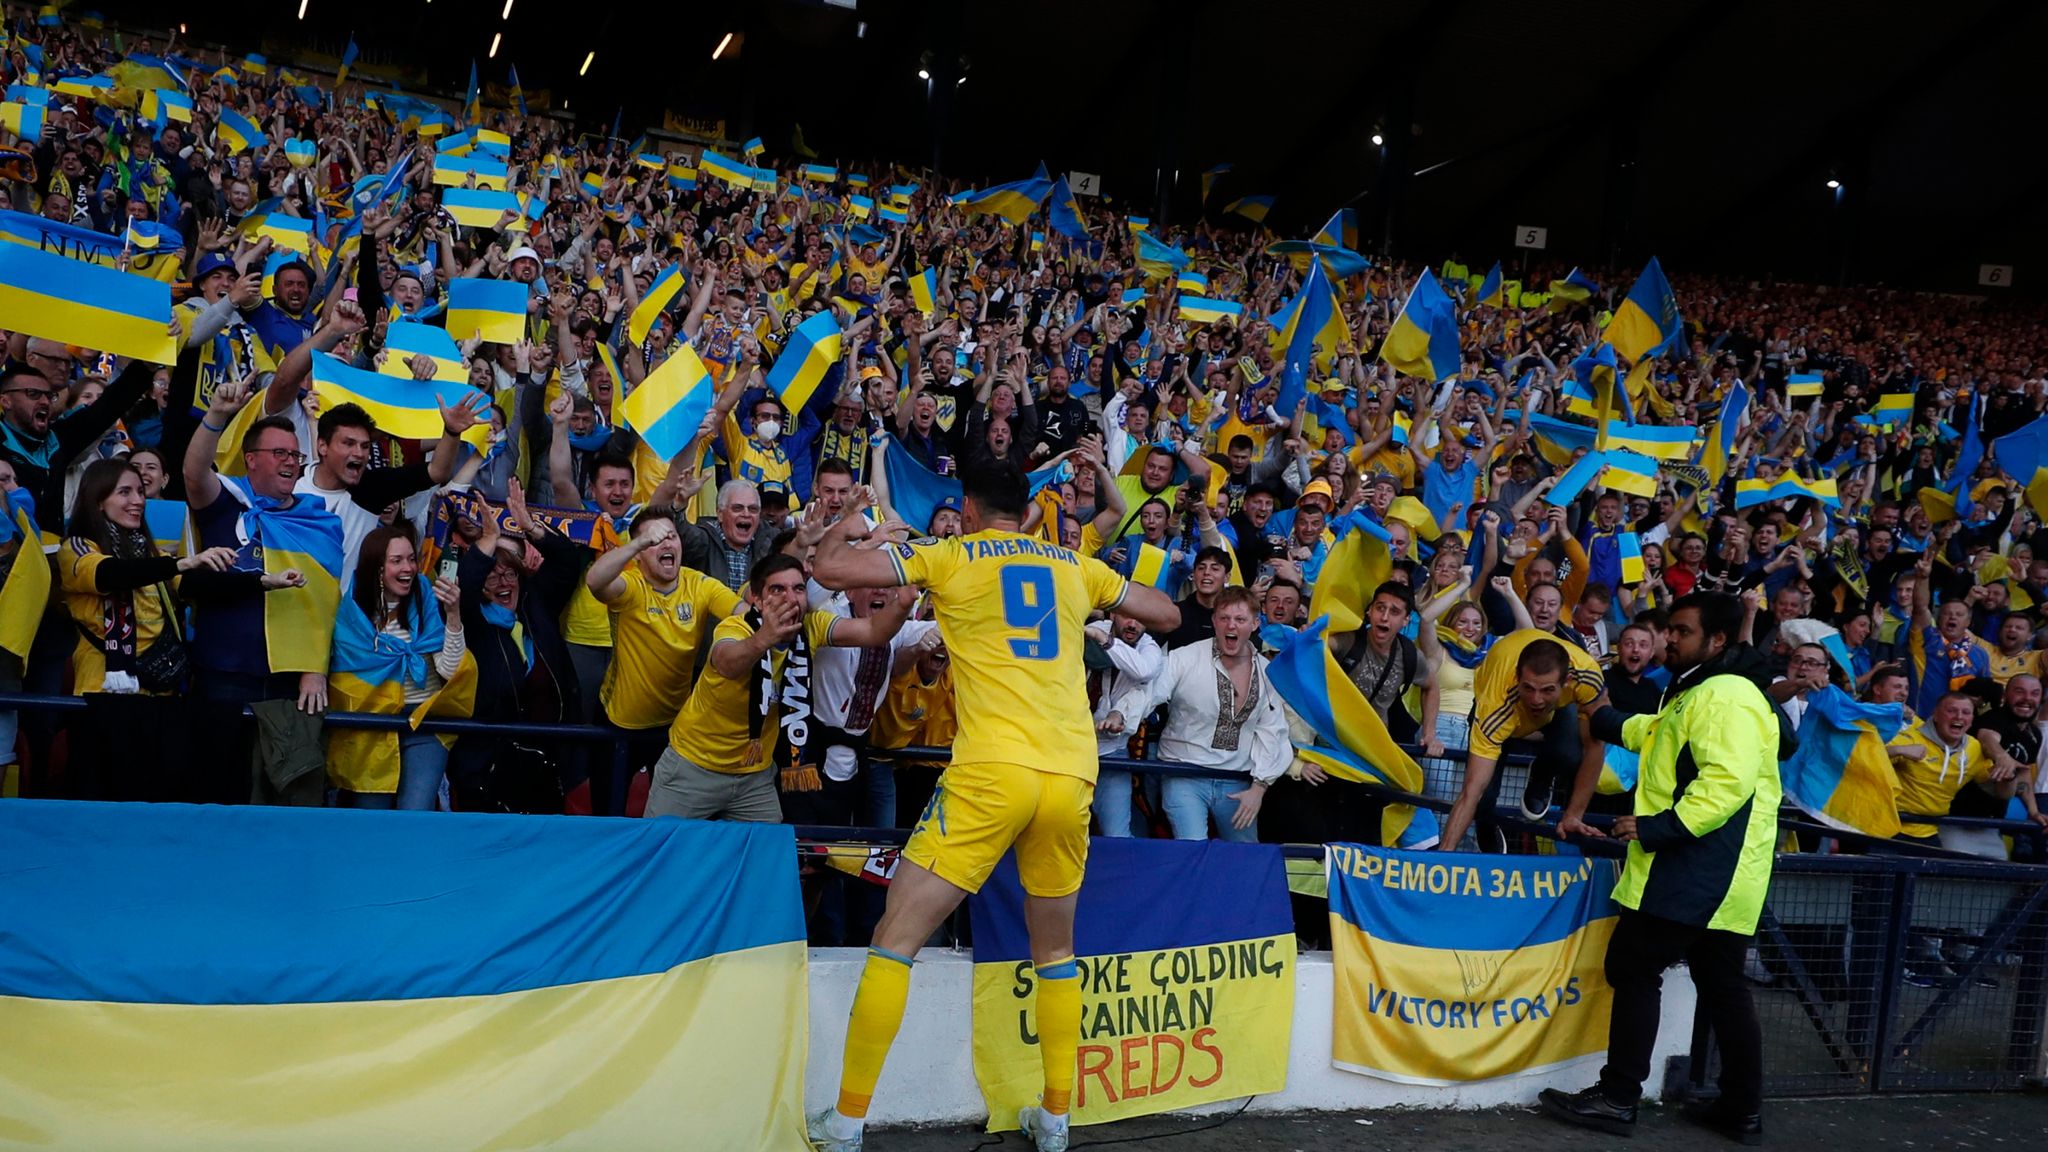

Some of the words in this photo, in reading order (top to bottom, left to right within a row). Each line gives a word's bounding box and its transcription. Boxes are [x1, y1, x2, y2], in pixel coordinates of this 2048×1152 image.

[1079, 177, 1090, 190] 4
[1525, 230, 1537, 244] 5
[1989, 268, 2002, 282] 6
[962, 538, 1079, 566] YAREMCHUK
[999, 563, 1060, 661] 9
[1490, 869, 1526, 898] ЗА
[1533, 857, 1593, 898] НА
[1012, 954, 1133, 998] SOKE
[1150, 939, 1284, 995] GOLDING
[1020, 987, 1213, 1045] UAINIAN
[1368, 982, 1486, 1029] VICTORY
[1492, 993, 1550, 1027] FOR
[1077, 1027, 1224, 1108] REDS
